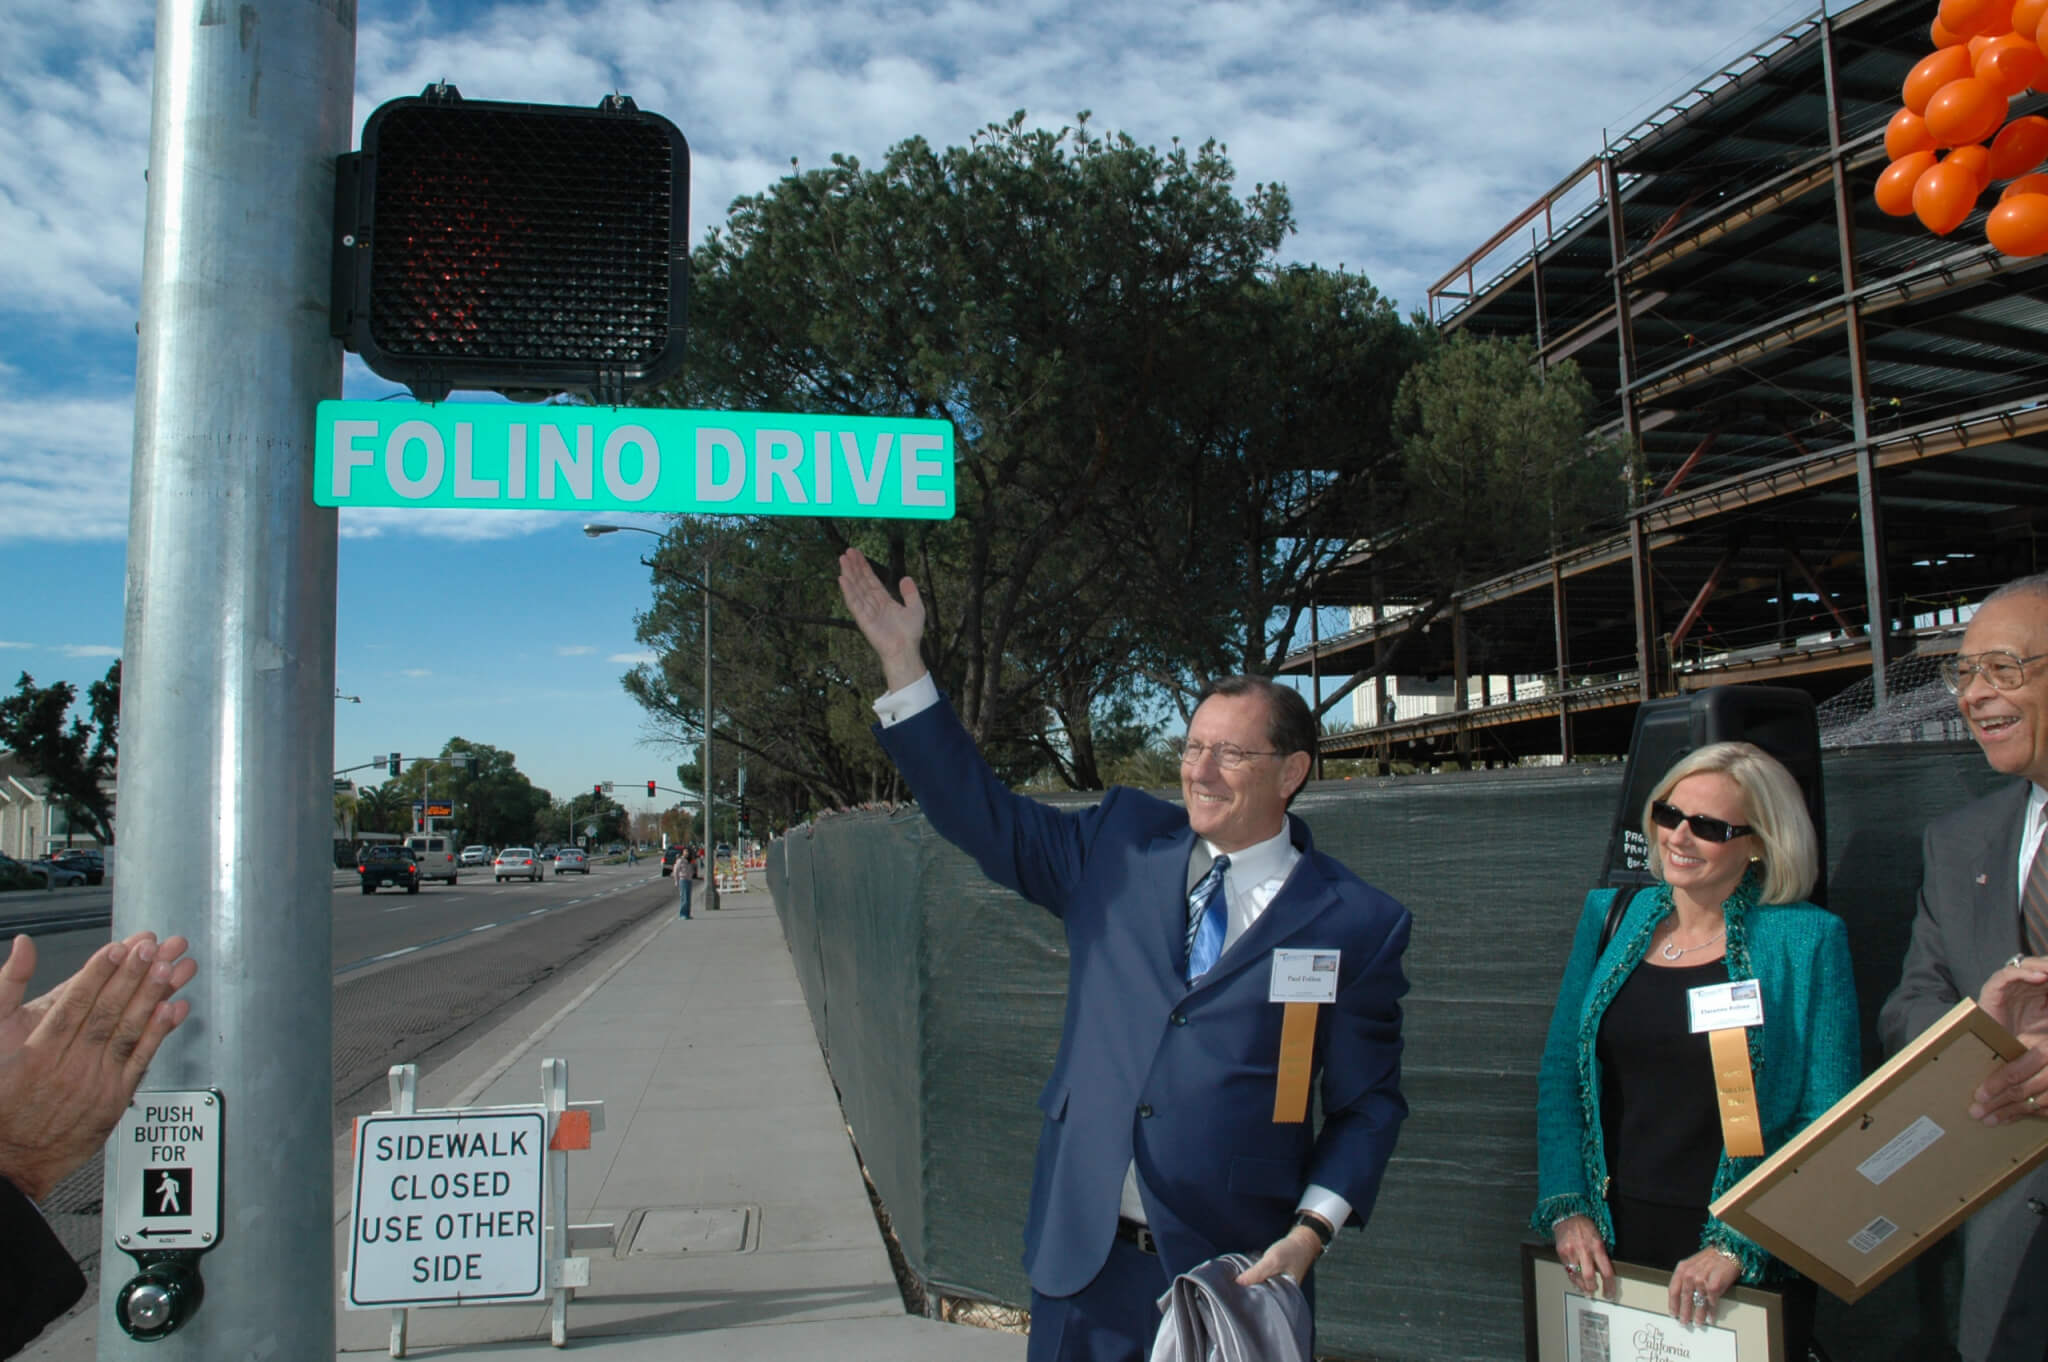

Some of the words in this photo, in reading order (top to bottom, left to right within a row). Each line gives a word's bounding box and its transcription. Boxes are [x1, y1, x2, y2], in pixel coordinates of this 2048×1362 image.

[331, 420, 661, 502] FOLINO
[694, 427, 946, 507] DRIVE
[146, 1106, 193, 1123] PUSH
[135, 1125, 203, 1142] BUTTON
[375, 1130, 528, 1161] SIDEWALK
[152, 1146, 185, 1162] FOR
[391, 1171, 510, 1201] CLOSED
[362, 1215, 423, 1244] USE
[435, 1210, 535, 1240] OTHER
[412, 1254, 482, 1283] SIDE
[1633, 1329, 1690, 1359] California
